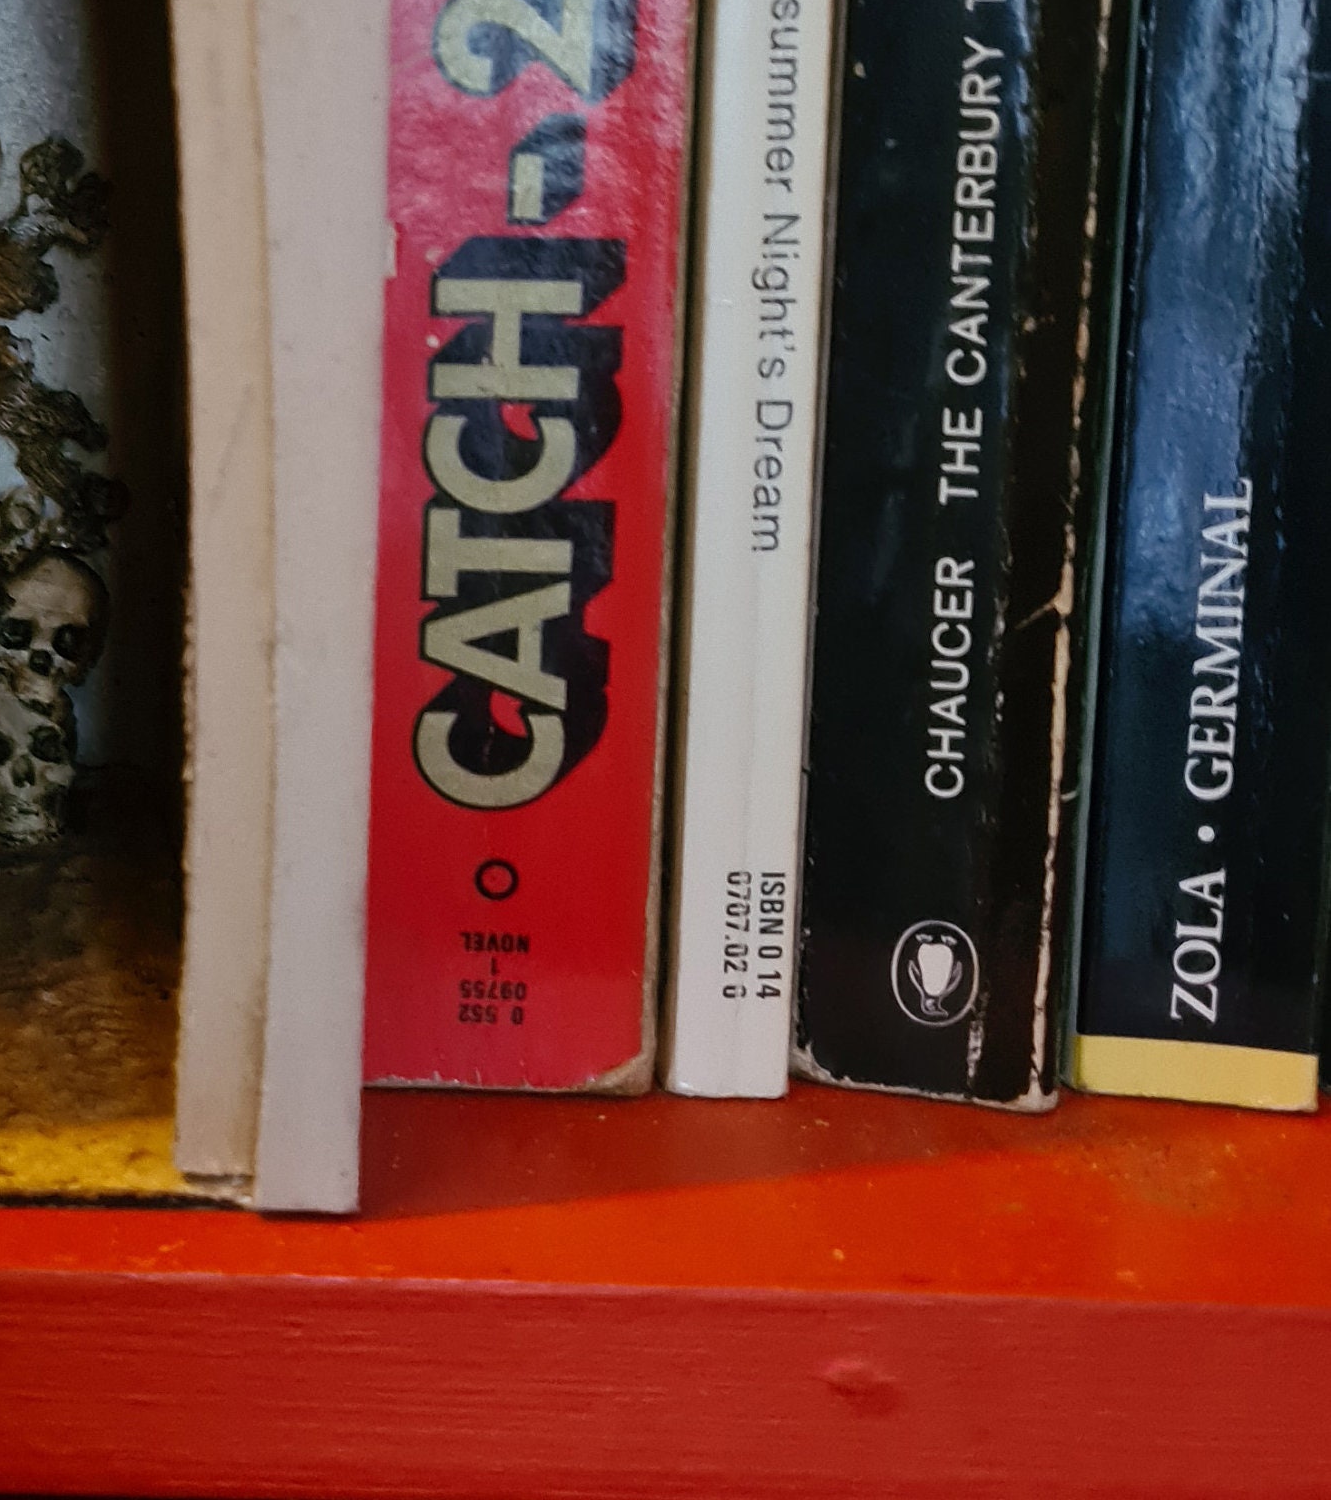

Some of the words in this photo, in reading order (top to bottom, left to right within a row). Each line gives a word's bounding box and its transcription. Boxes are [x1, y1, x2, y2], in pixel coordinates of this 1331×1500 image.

[945, 36, 1004, 386] CANTERBURY
[750, 212, 803, 381] Night's
[750, 398, 795, 553] Dream
[938, 406, 983, 505] THE
[923, 555, 975, 800] CHAUCER
[1184, 476, 1253, 802] GERMINAL
[459, 932, 530, 954] NOVEL
[757, 945, 783, 959] 0
[758, 872, 786, 935] ISBN
[1169, 866, 1226, 1024] ZOLA
[756, 970, 782, 1000] 14
